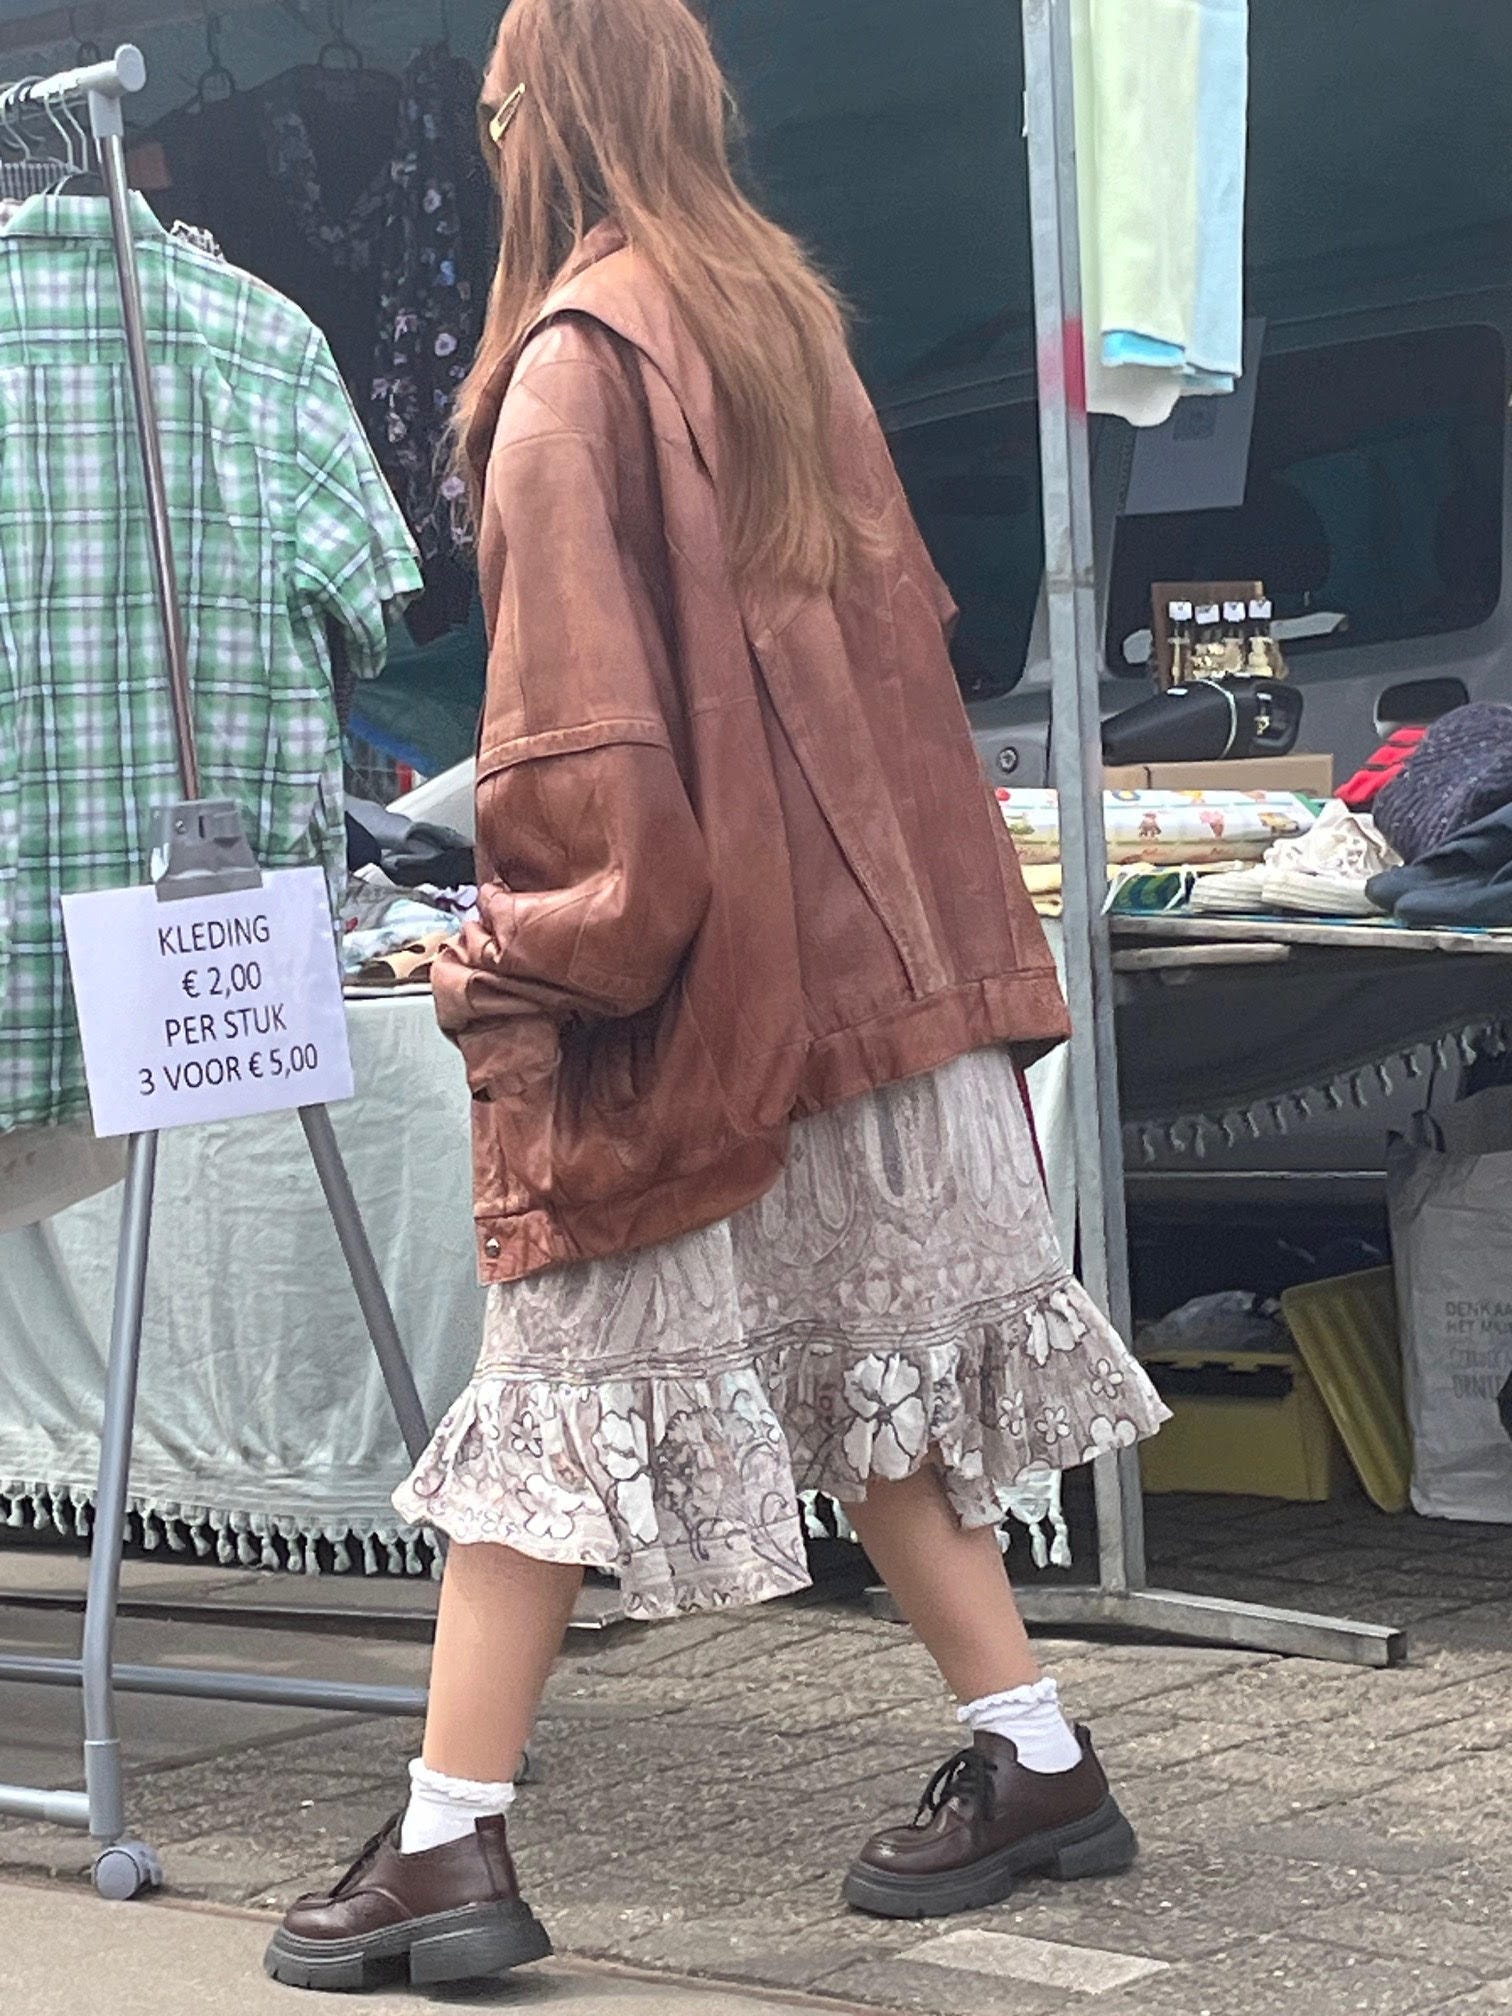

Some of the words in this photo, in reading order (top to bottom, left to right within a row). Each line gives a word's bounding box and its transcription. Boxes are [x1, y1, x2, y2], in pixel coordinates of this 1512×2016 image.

[158, 914, 270, 956] KLEDING
[182, 969, 200, 998] €
[208, 961, 262, 998] 2,00
[165, 1014, 217, 1047] PER
[224, 1003, 287, 1039] STUK
[139, 1068, 155, 1095] 3
[163, 1055, 242, 1091] VOOR
[249, 1051, 264, 1078] €
[270, 1042, 318, 1079] 5,00
